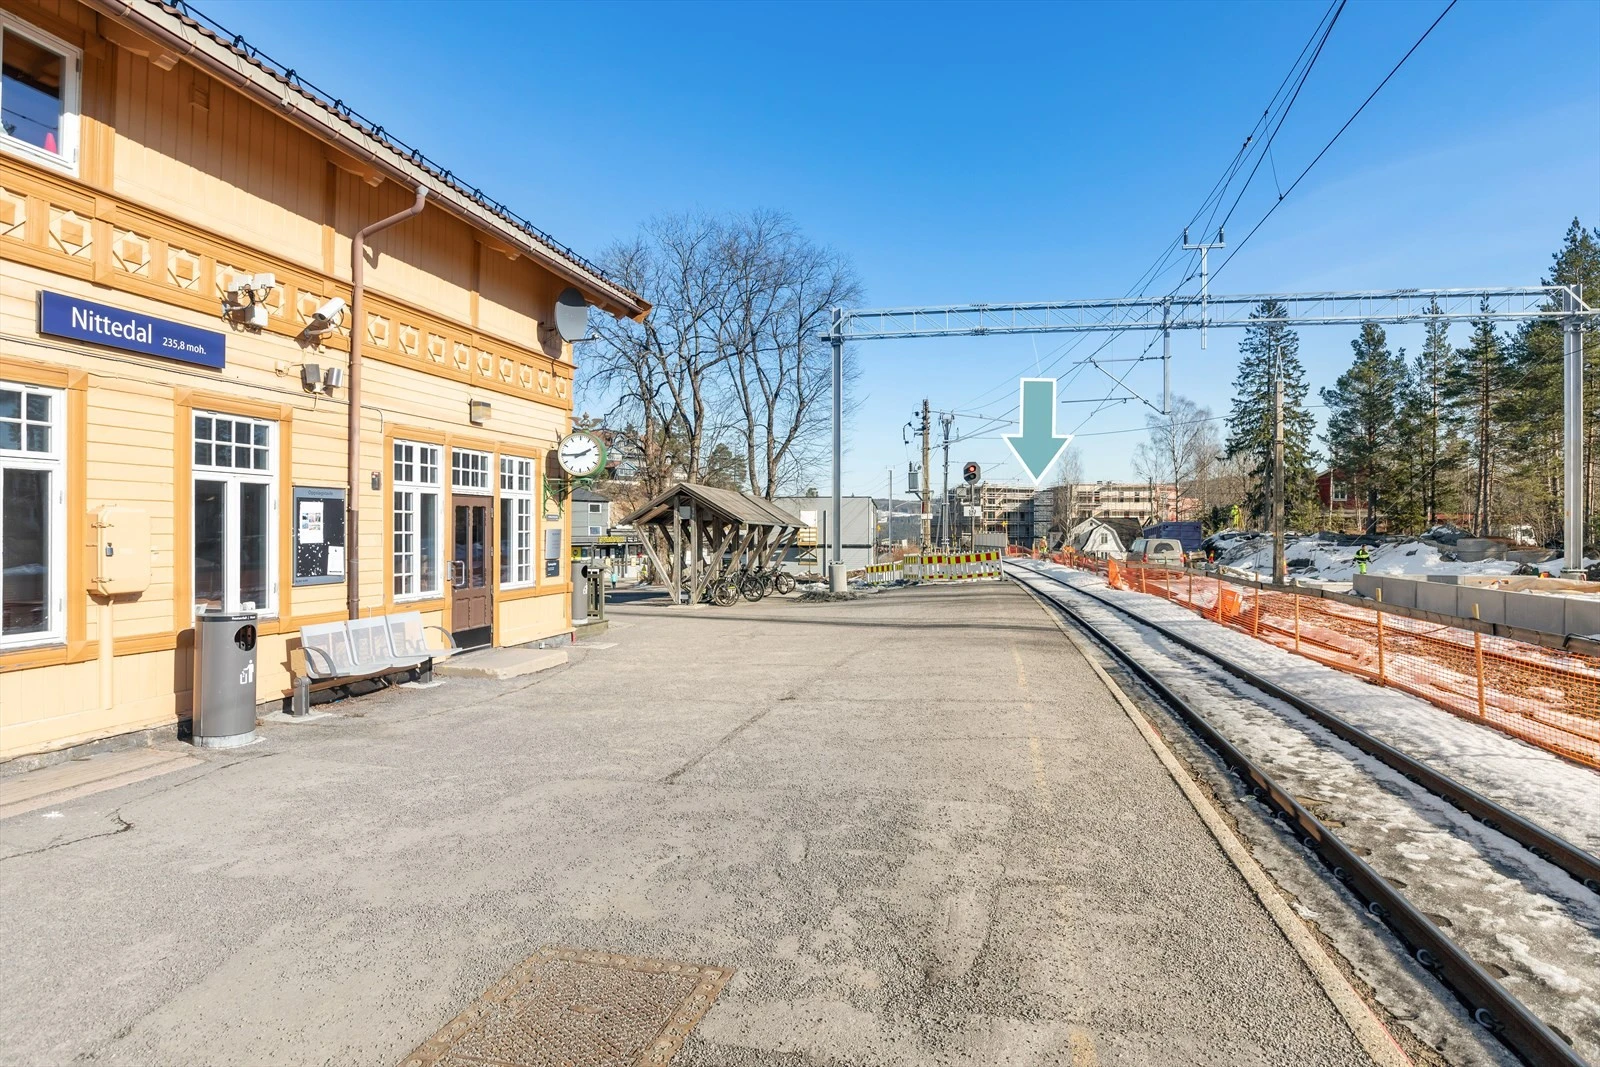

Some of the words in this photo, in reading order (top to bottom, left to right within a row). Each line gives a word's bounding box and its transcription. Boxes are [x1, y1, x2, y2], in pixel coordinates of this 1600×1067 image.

[72, 306, 152, 344] Nittedal
[162, 337, 185, 351] 235,8
[186, 344, 207, 355] moh.
